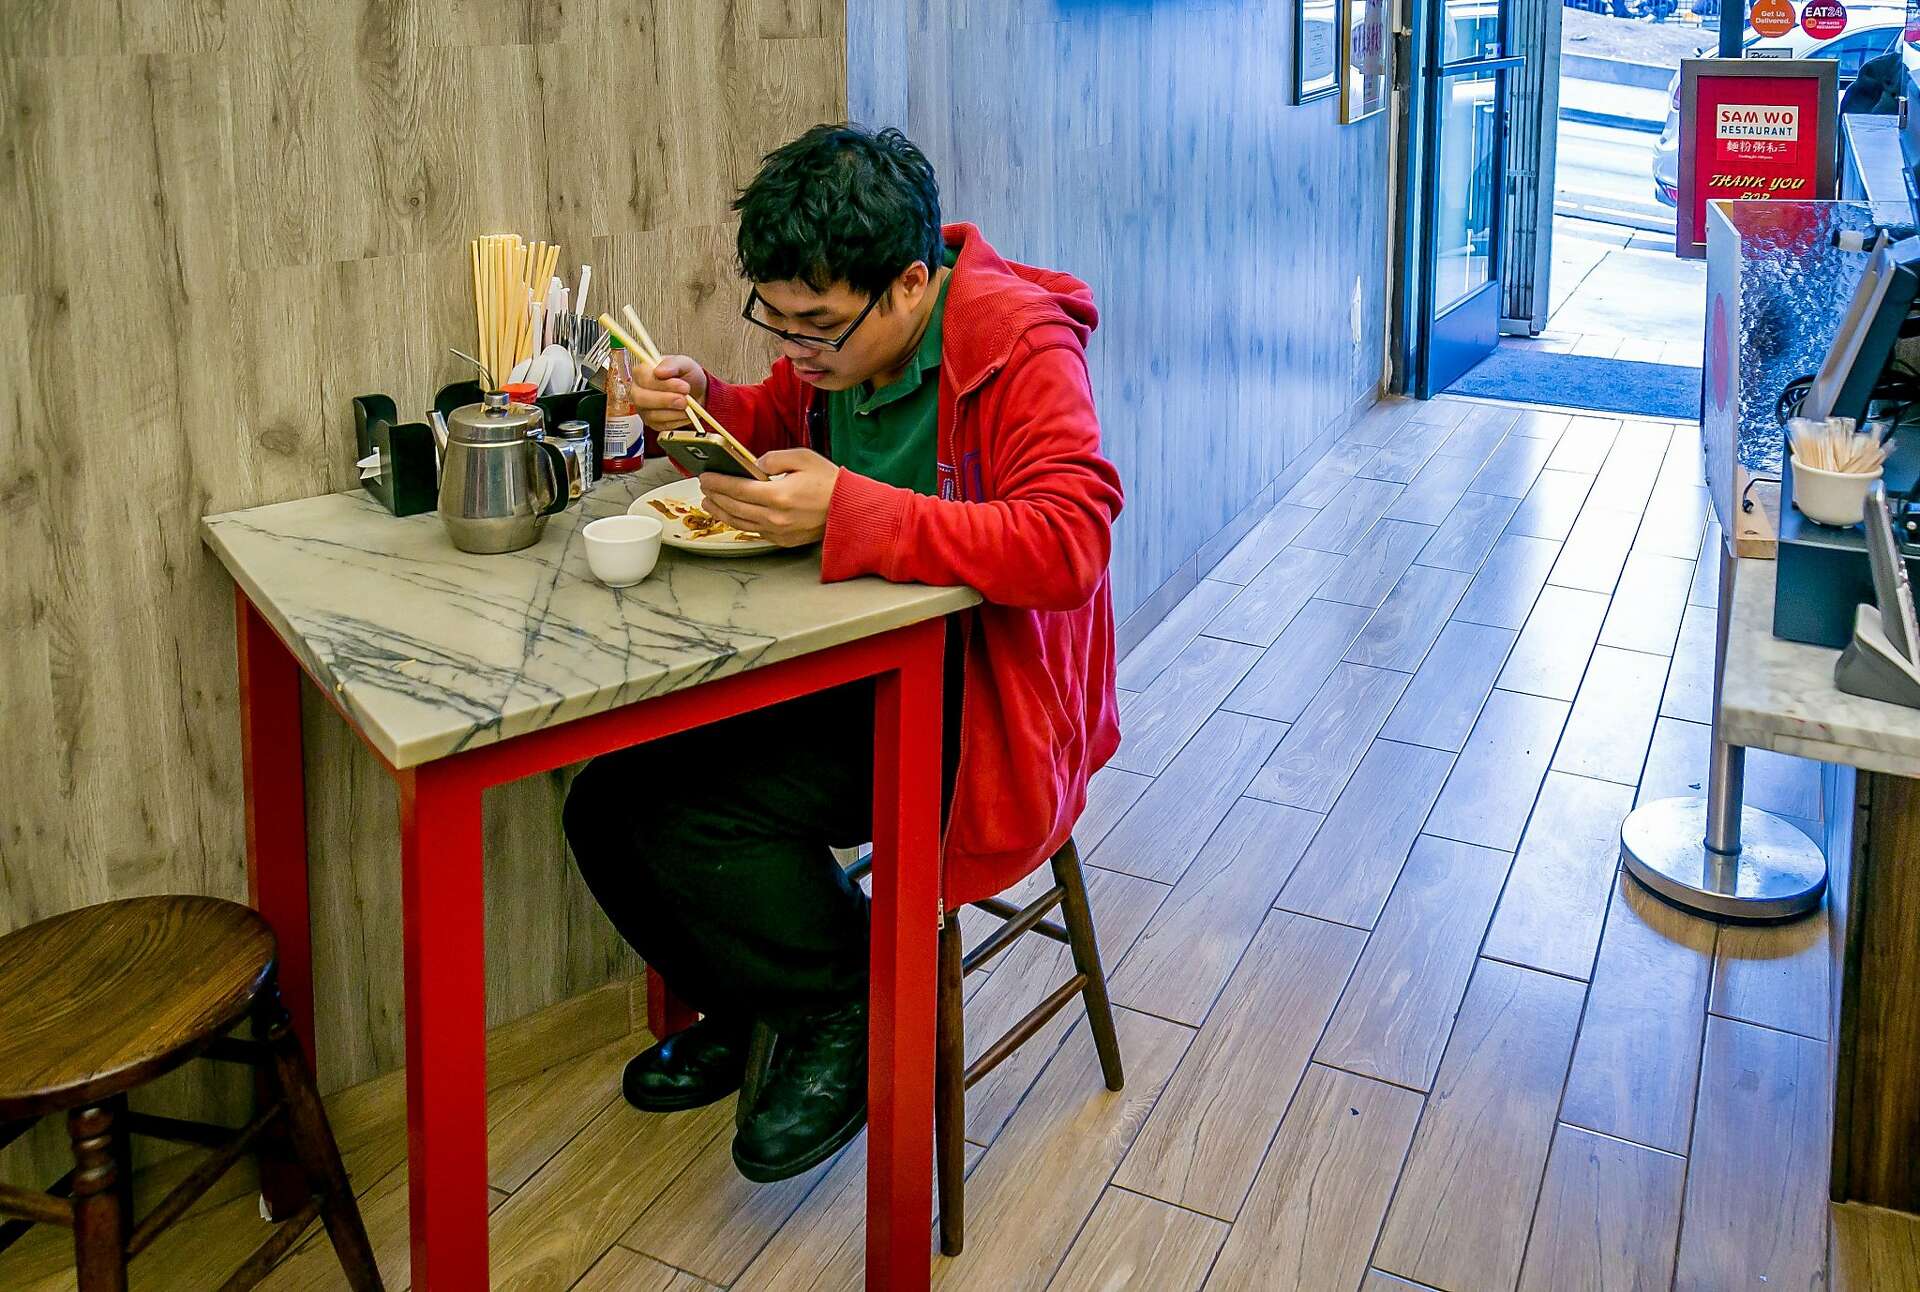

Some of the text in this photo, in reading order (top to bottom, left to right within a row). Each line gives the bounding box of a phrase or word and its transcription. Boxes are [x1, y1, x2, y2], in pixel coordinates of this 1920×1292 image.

[1805, 6, 1843, 17] EAT24
[1721, 110, 1794, 124] SAM WO
[1721, 125, 1793, 136] RESTAURANT
[1709, 174, 1806, 191] THANK YOU
